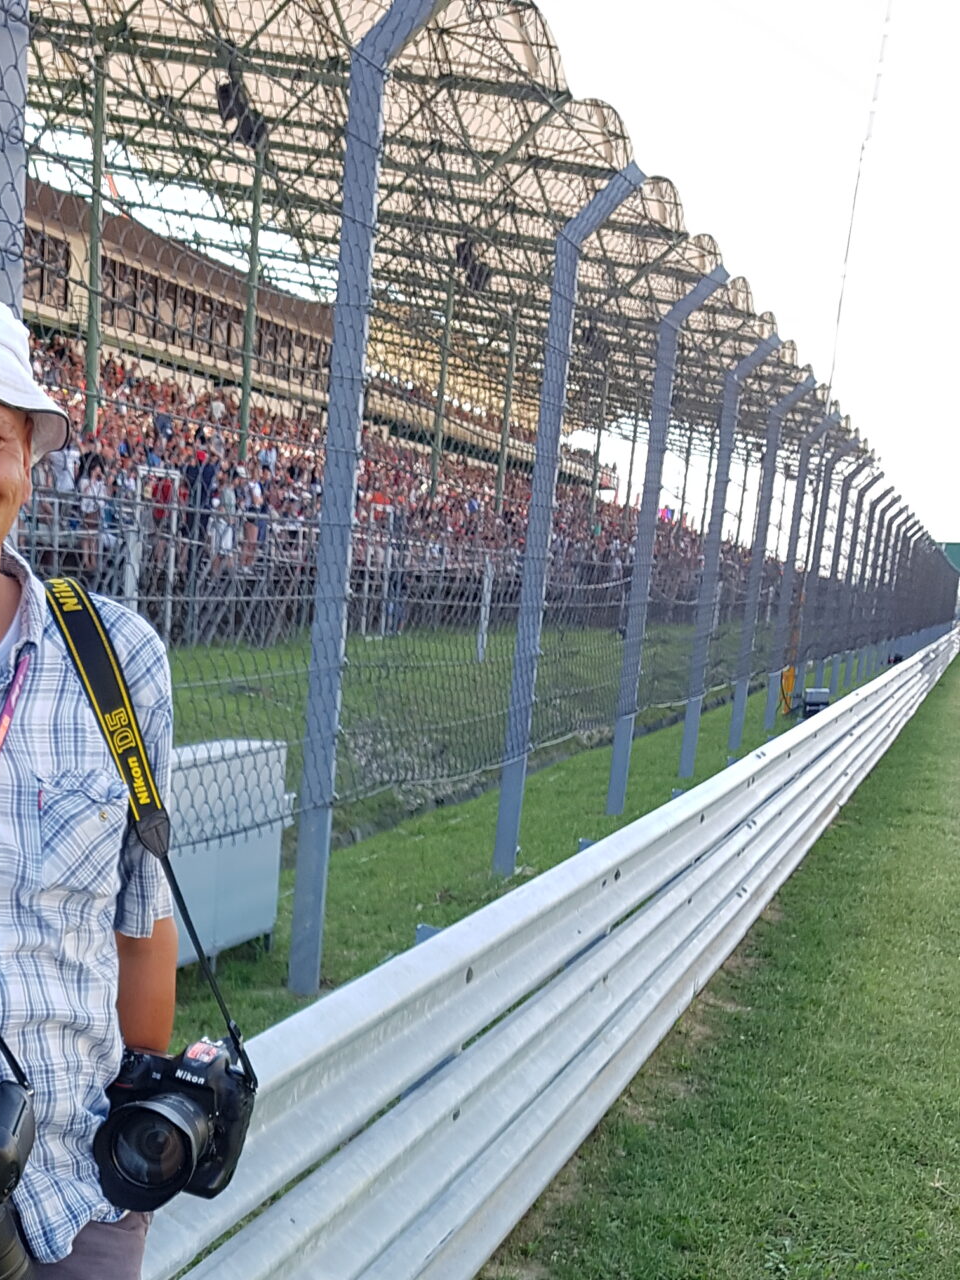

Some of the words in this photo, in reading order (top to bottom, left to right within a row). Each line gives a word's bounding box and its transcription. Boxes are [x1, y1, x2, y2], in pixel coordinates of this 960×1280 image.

[104, 707, 137, 754] D5
[127, 756, 151, 805] Nikon
[175, 1068, 206, 1085] Nikon
